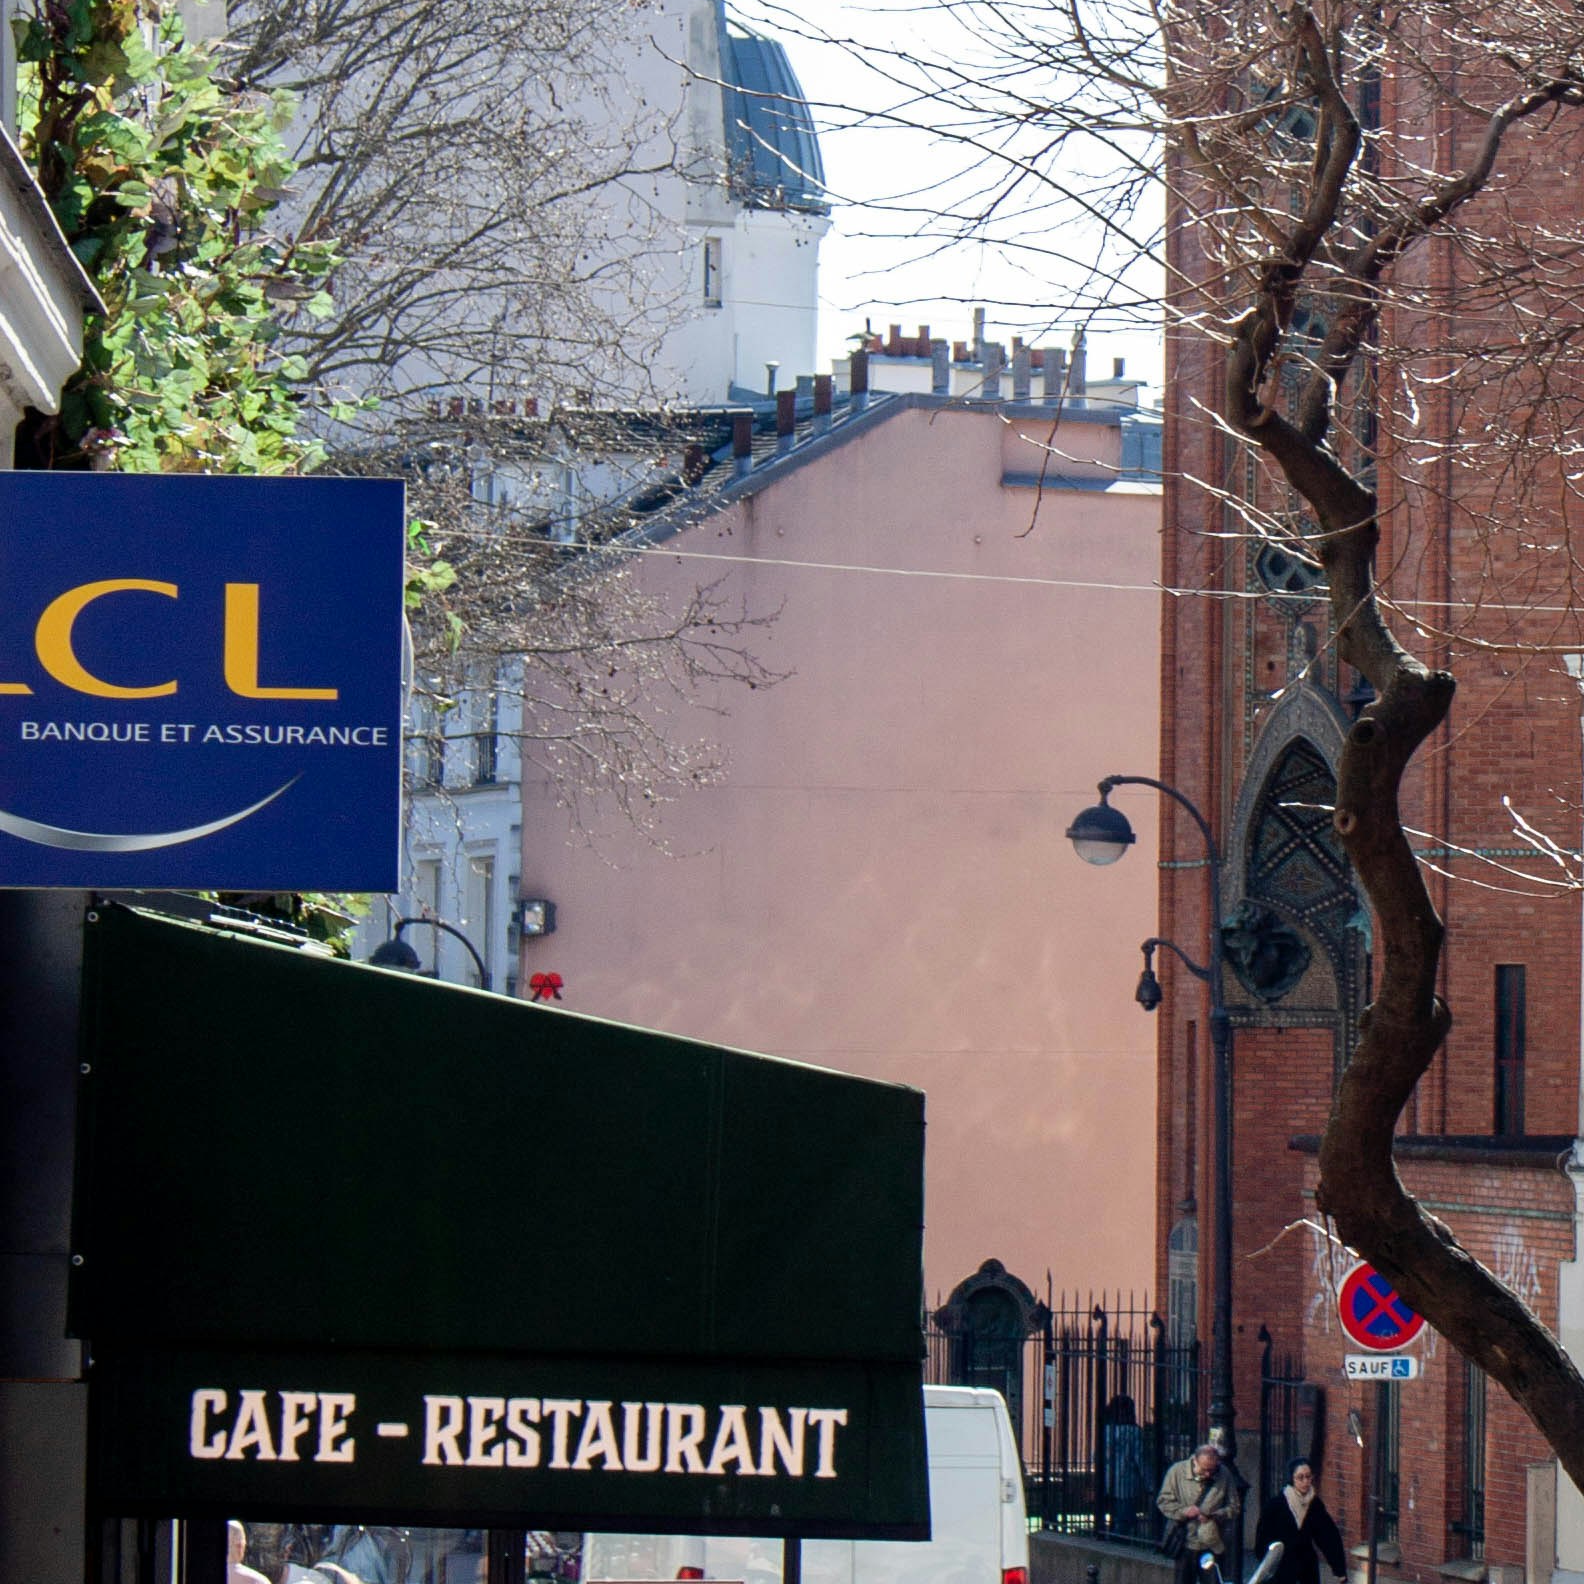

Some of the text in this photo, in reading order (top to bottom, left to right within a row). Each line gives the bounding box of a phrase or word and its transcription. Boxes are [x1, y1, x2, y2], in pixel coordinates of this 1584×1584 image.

[20, 720, 389, 746] BANQUE ET ASSURANCE
[1348, 1361, 1389, 1374] SAUF
[190, 1388, 357, 1463] CAFE
[421, 1394, 849, 1478] RESTAURANT
